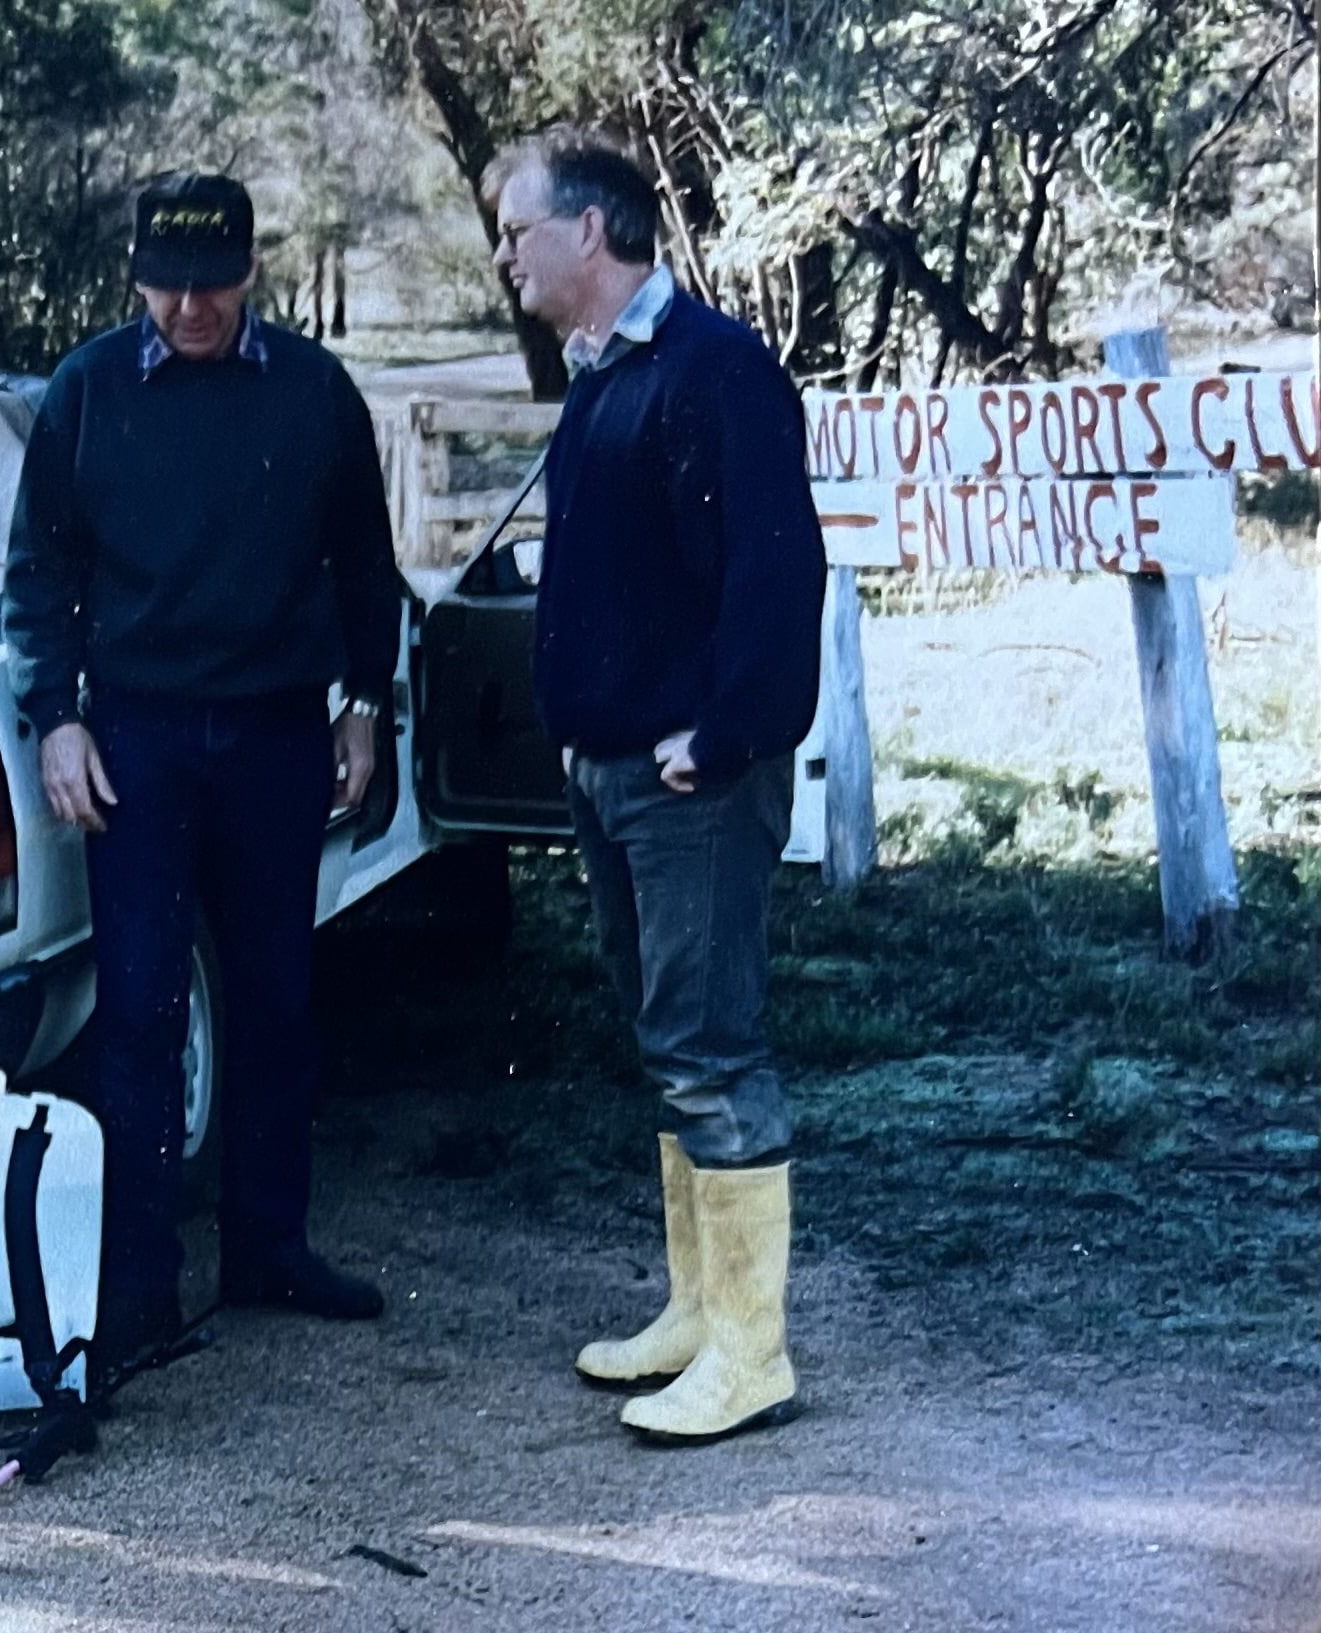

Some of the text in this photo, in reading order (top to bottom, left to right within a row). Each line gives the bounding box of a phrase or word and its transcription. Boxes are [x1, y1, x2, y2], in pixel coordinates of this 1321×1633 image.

[806, 393, 952, 478] MOTOR
[980, 381, 1167, 479] SPORTS
[895, 482, 1164, 574] ENTRANCE
